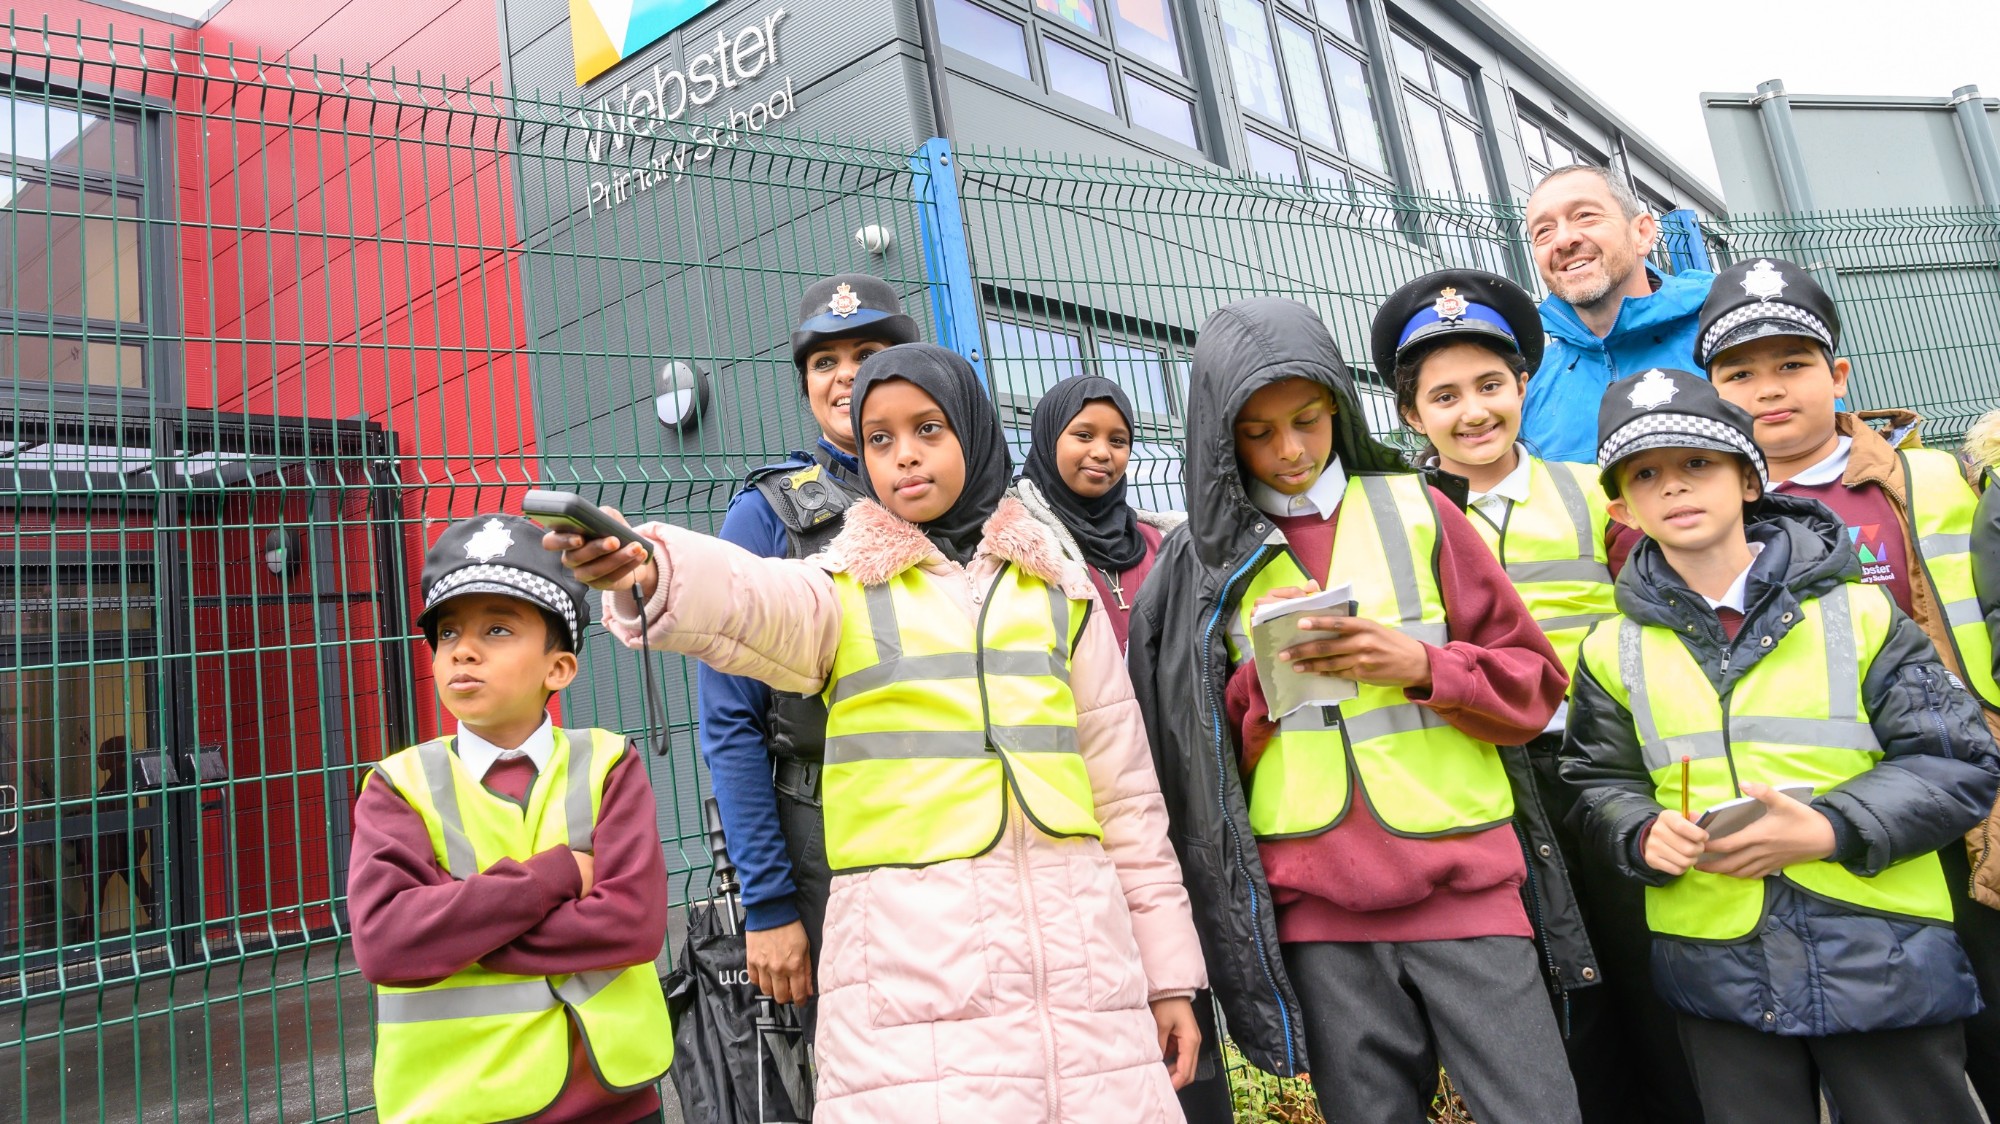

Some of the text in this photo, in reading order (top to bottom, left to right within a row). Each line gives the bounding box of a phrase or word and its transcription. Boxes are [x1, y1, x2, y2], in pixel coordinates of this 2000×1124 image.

[578, 8, 785, 162] Webster
[587, 76, 795, 219] Primary School
[1862, 564, 1891, 576] bster
[1872, 572, 1895, 582] School
